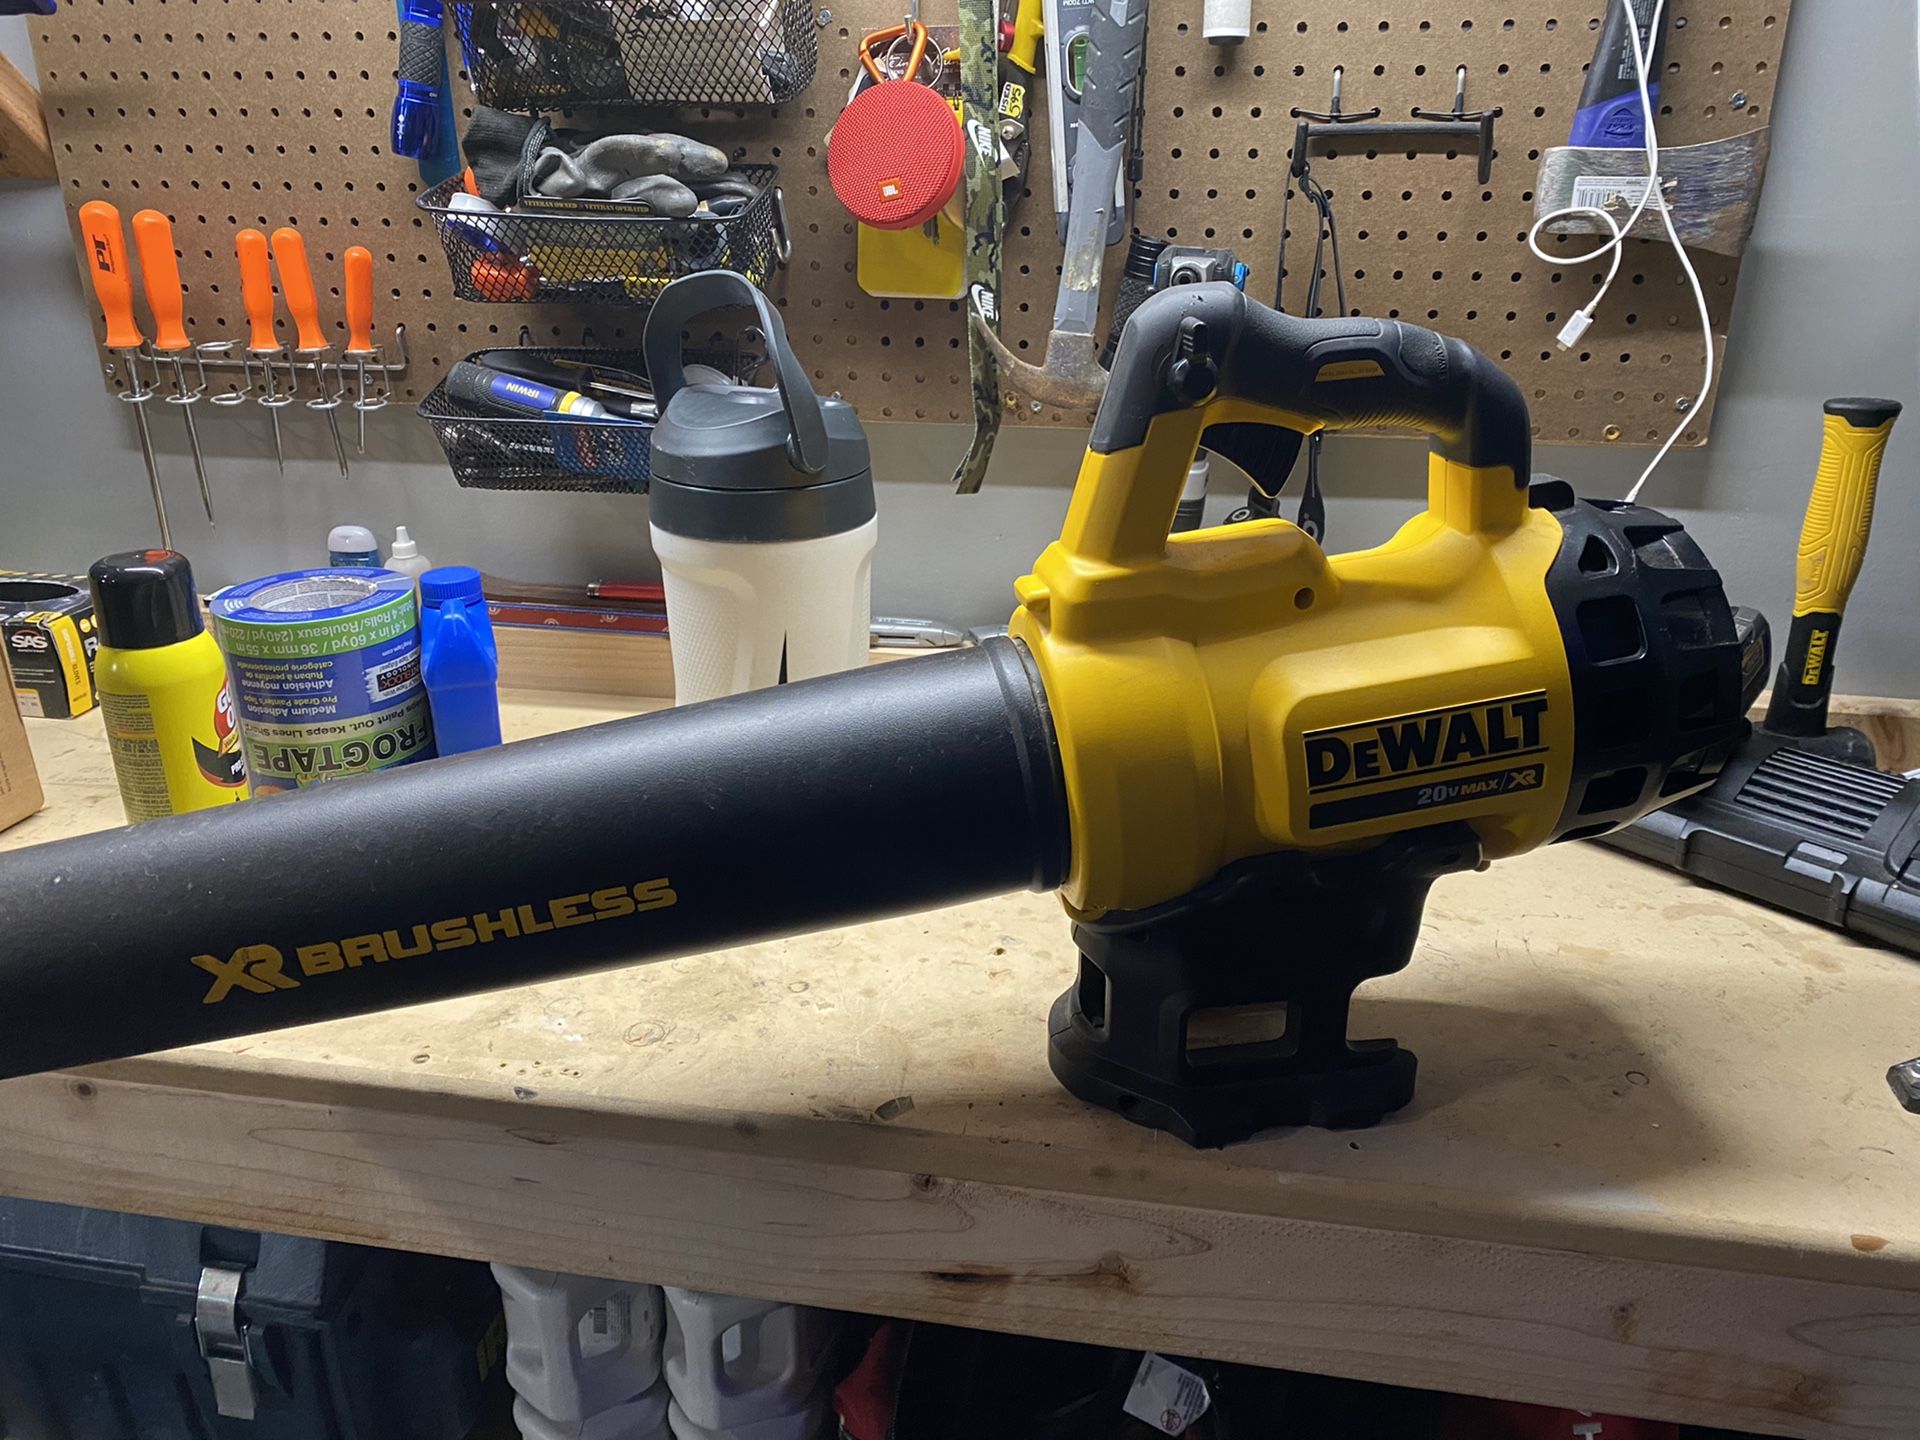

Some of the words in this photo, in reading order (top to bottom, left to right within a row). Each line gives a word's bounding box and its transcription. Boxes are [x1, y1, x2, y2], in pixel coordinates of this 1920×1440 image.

[1000, 84, 1011, 112] USED
[1009, 87, 1022, 118] 595
[882, 184, 899, 197] JBL
[523, 200, 555, 208] VETERAN
[584, 204, 614, 212] VETERAN
[505, 382, 541, 399] IRWIN
[11, 635, 48, 649] SAS
[1801, 629, 1829, 686] DeWALT
[291, 660, 333, 670] catégorie
[294, 671, 323, 680] Ruban
[241, 679, 280, 690] moyenne
[282, 679, 334, 692] Adhésion
[243, 694, 258, 704] Tape
[294, 697, 320, 705] Grade
[321, 695, 338, 703] Pro
[247, 704, 288, 717] Adhesion
[291, 704, 337, 716] Medium
[376, 709, 404, 724] Paint
[349, 717, 375, 731] Out.
[272, 728, 303, 738] Lines
[306, 725, 346, 737] Keeps
[253, 717, 430, 773] FROGTAPE
[190, 943, 301, 1005] XR
[296, 877, 679, 977] BRUSHLESS
